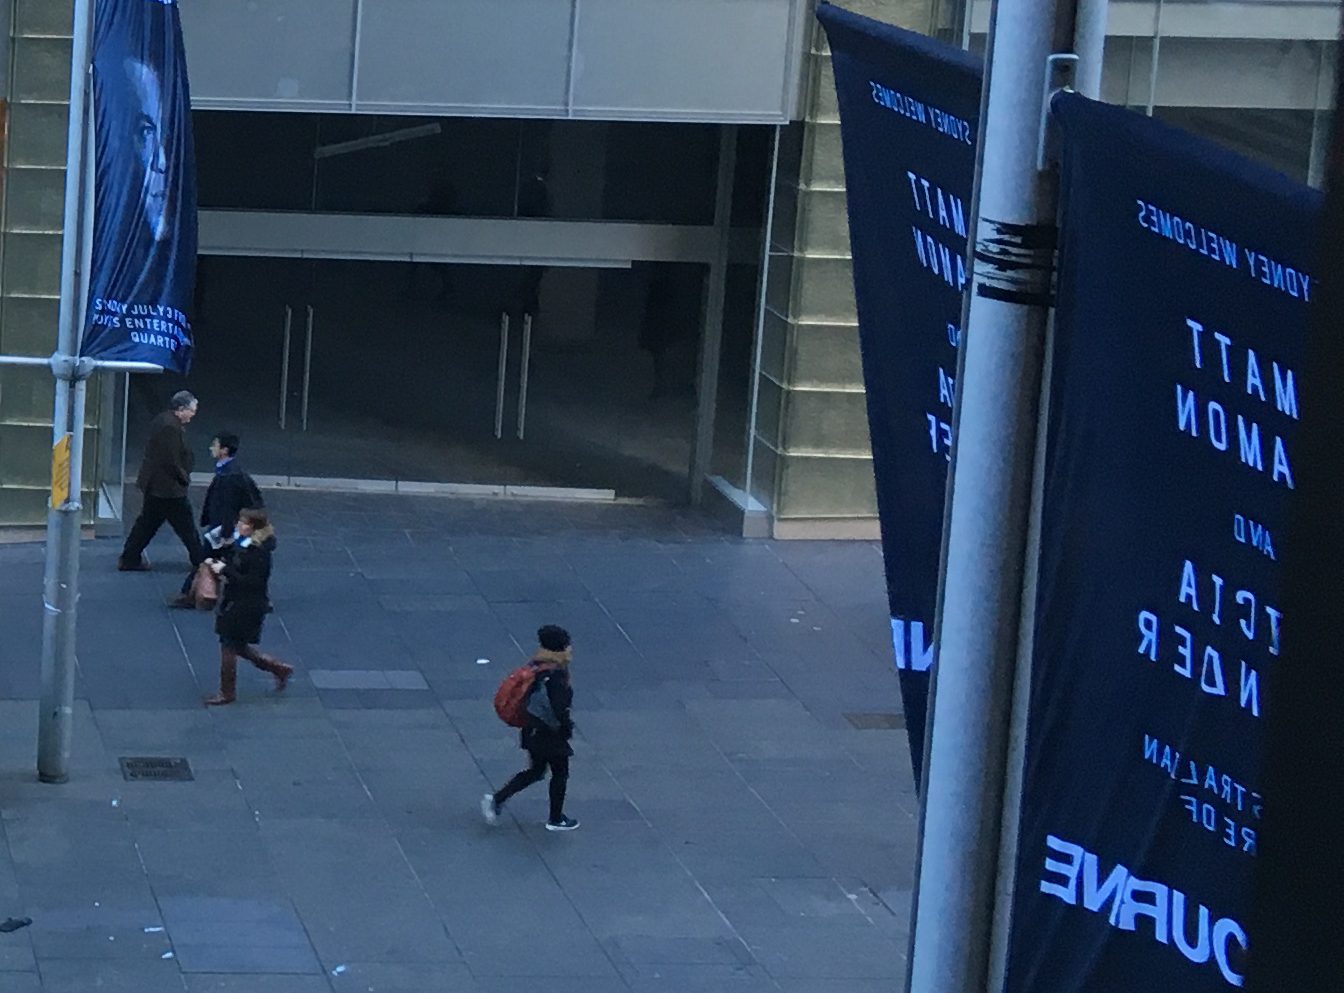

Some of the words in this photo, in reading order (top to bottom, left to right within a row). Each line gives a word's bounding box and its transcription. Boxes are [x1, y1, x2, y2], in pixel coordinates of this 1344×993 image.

[131, 303, 165, 316] JULY
[166, 306, 173, 319] 3
[130, 331, 177, 352] QUARTE
